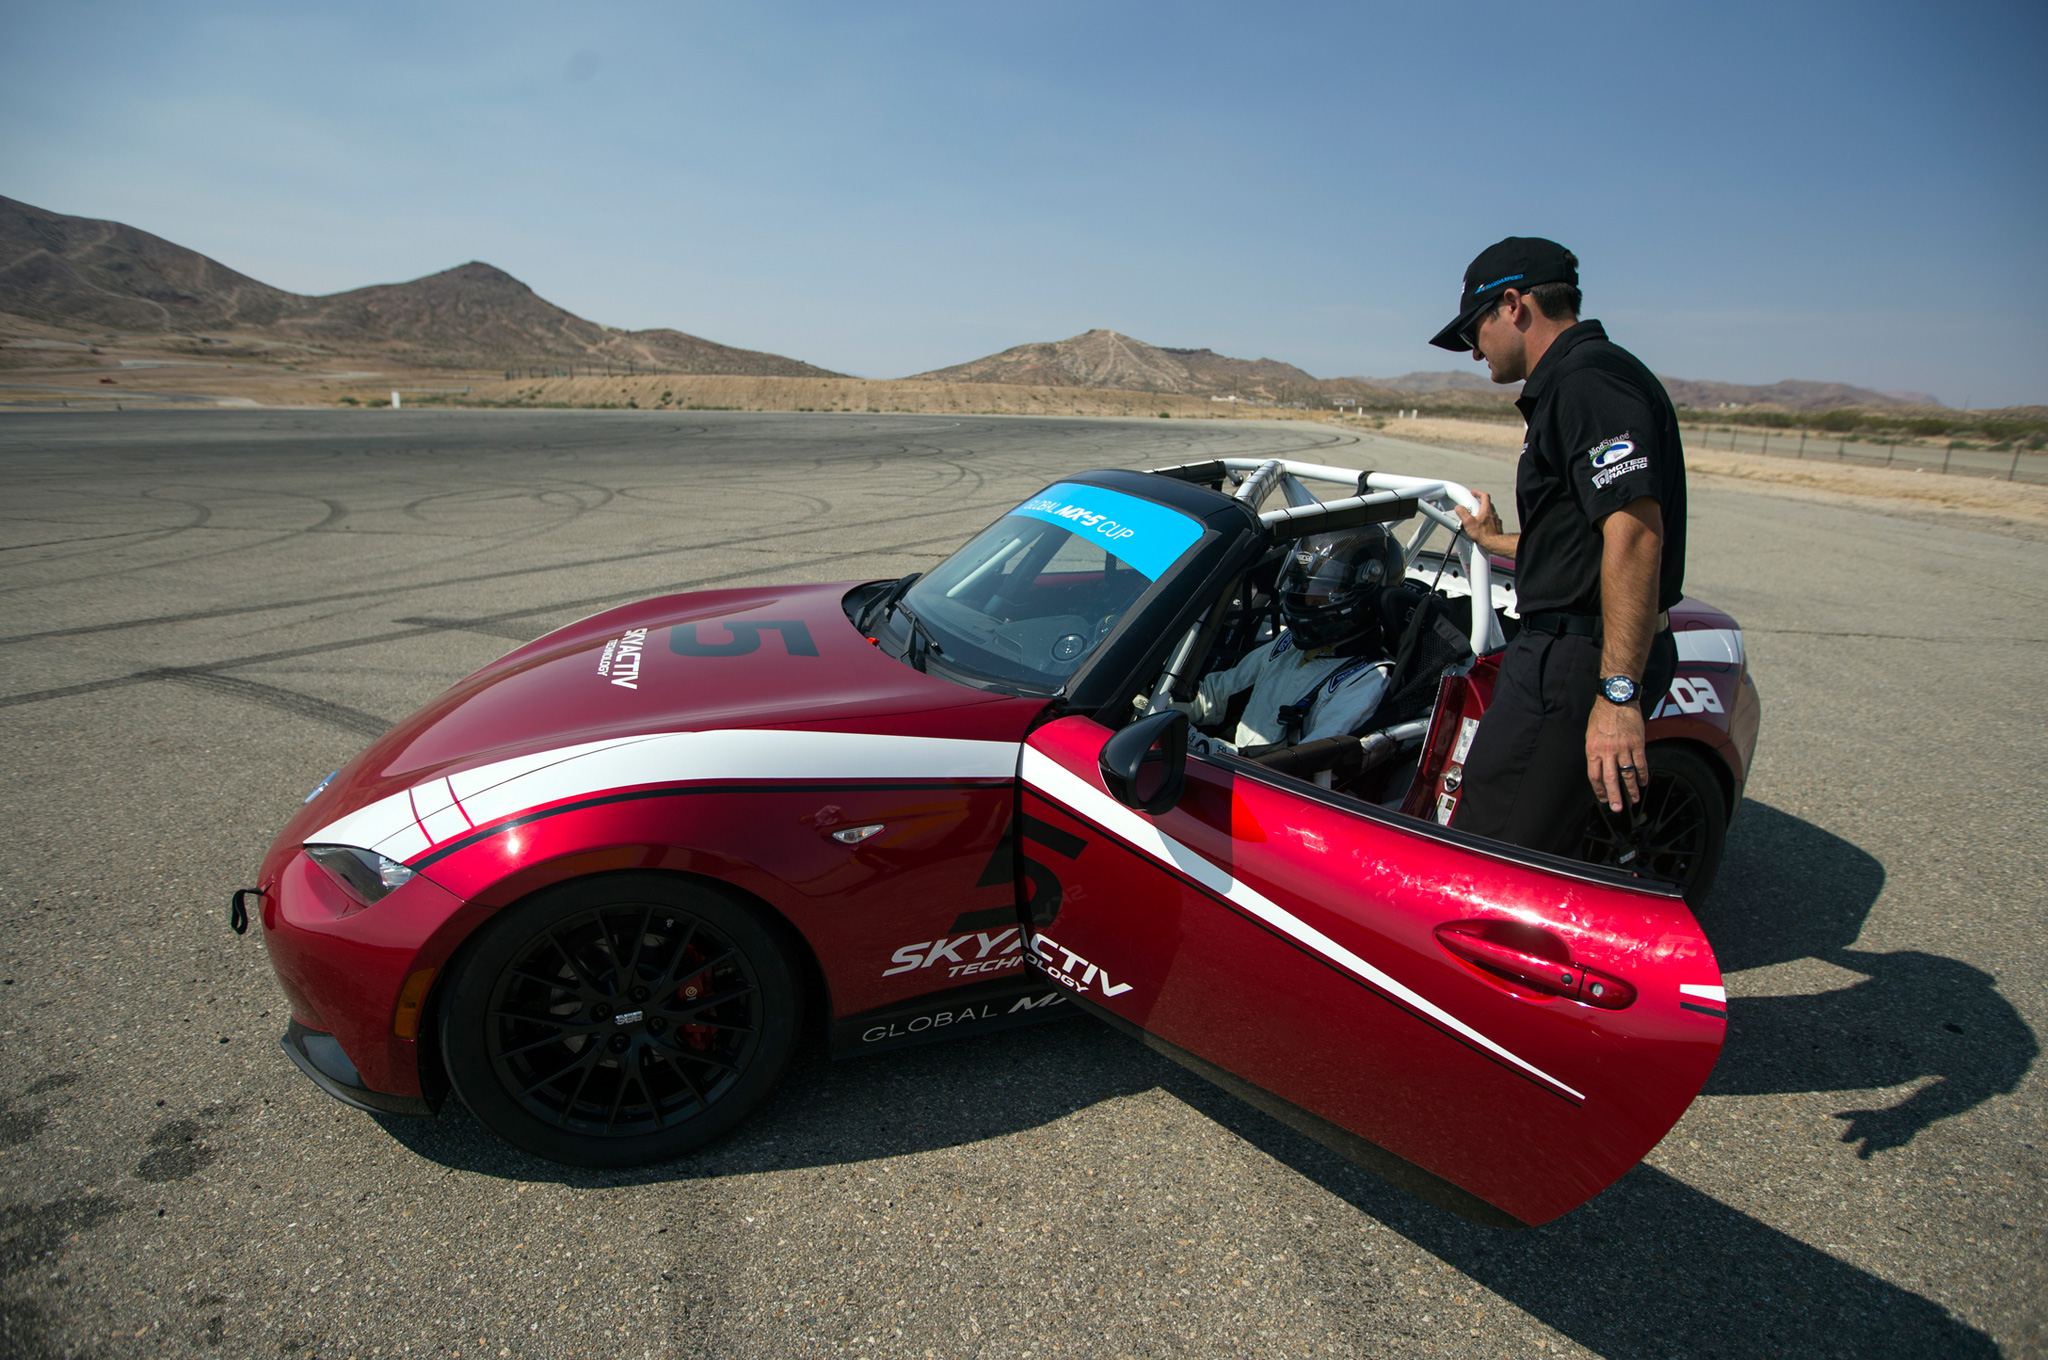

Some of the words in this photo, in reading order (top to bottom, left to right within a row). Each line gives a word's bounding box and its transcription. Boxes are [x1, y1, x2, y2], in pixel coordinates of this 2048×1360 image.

[1054, 505, 1107, 526] MX-5
[1097, 520, 1135, 540] CUP
[669, 620, 820, 657] 5
[597, 639, 619, 676] TECHNOLOGY
[611, 628, 648, 690] SKYACTIV
[882, 922, 1134, 998] SKYACTIV
[615, 1011, 643, 1025] BBS
[862, 1005, 998, 1042] GLOBAL
